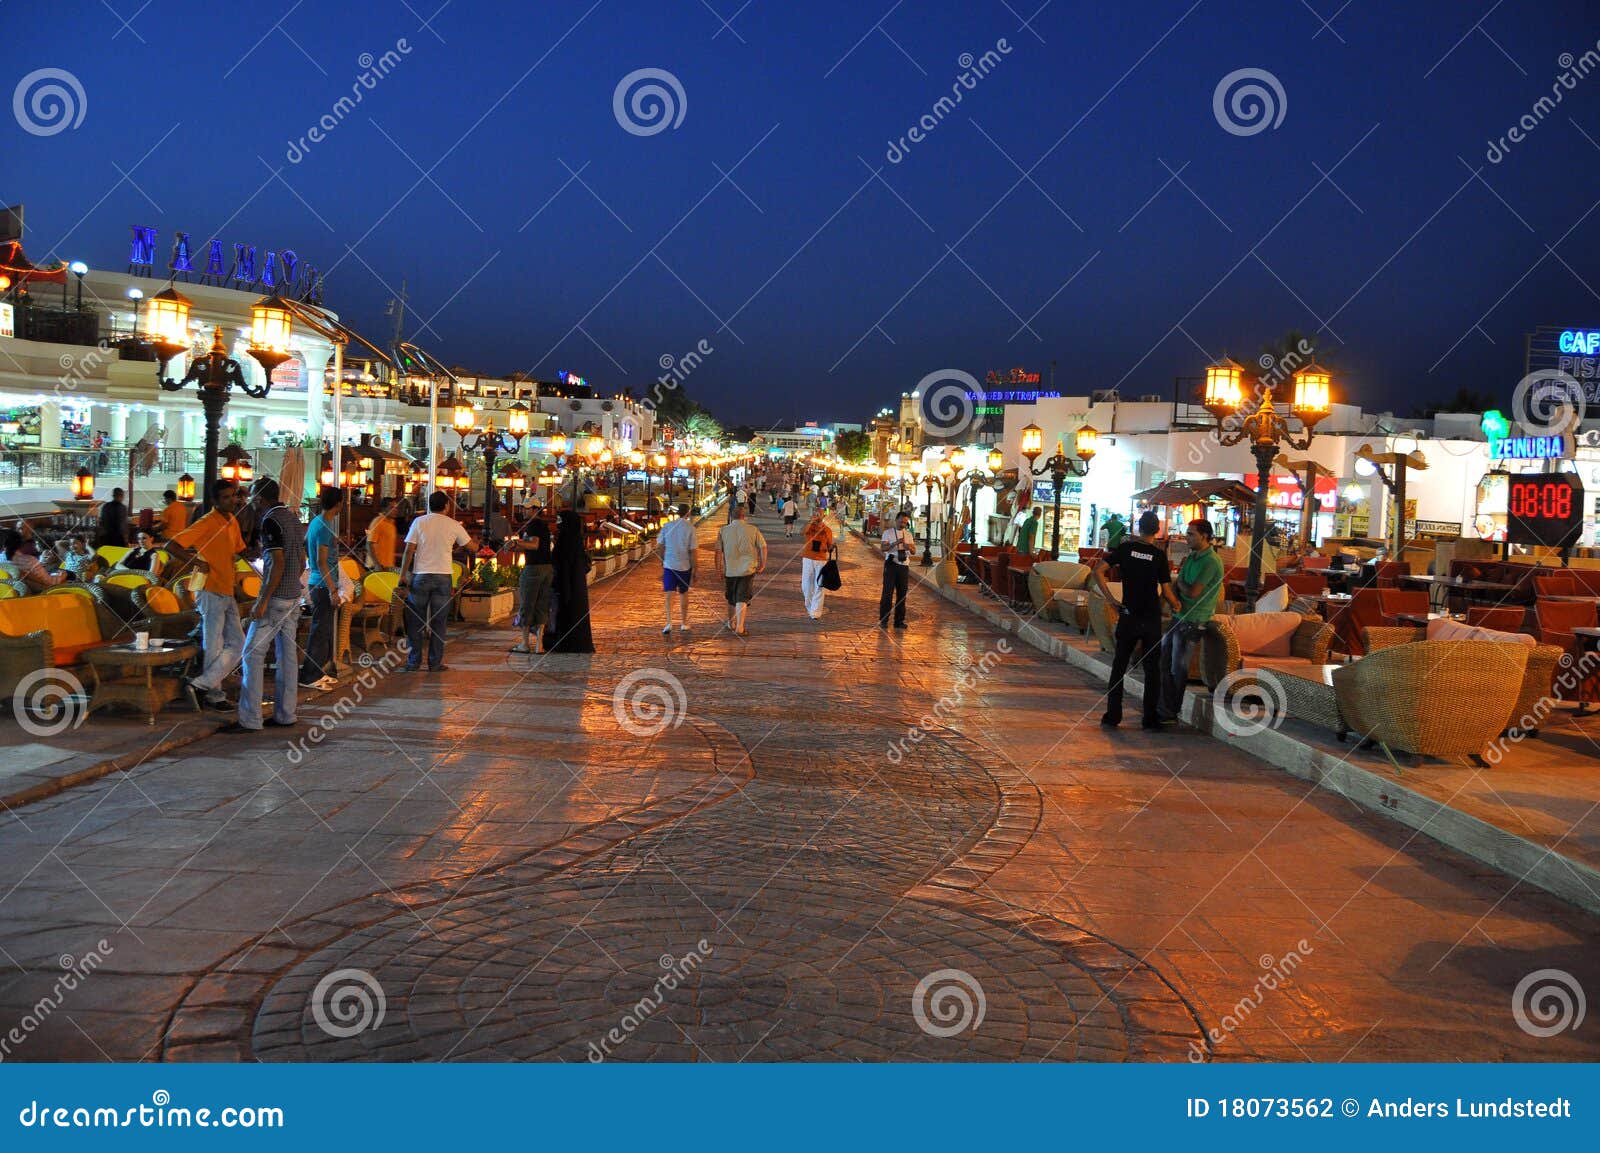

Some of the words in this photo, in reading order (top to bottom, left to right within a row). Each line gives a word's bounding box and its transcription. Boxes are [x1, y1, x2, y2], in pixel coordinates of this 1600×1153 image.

[975, 406, 1003, 415] HOTELS
[1495, 436, 1563, 458] ZEINUBIA
[1511, 483, 1572, 519] 08:08
